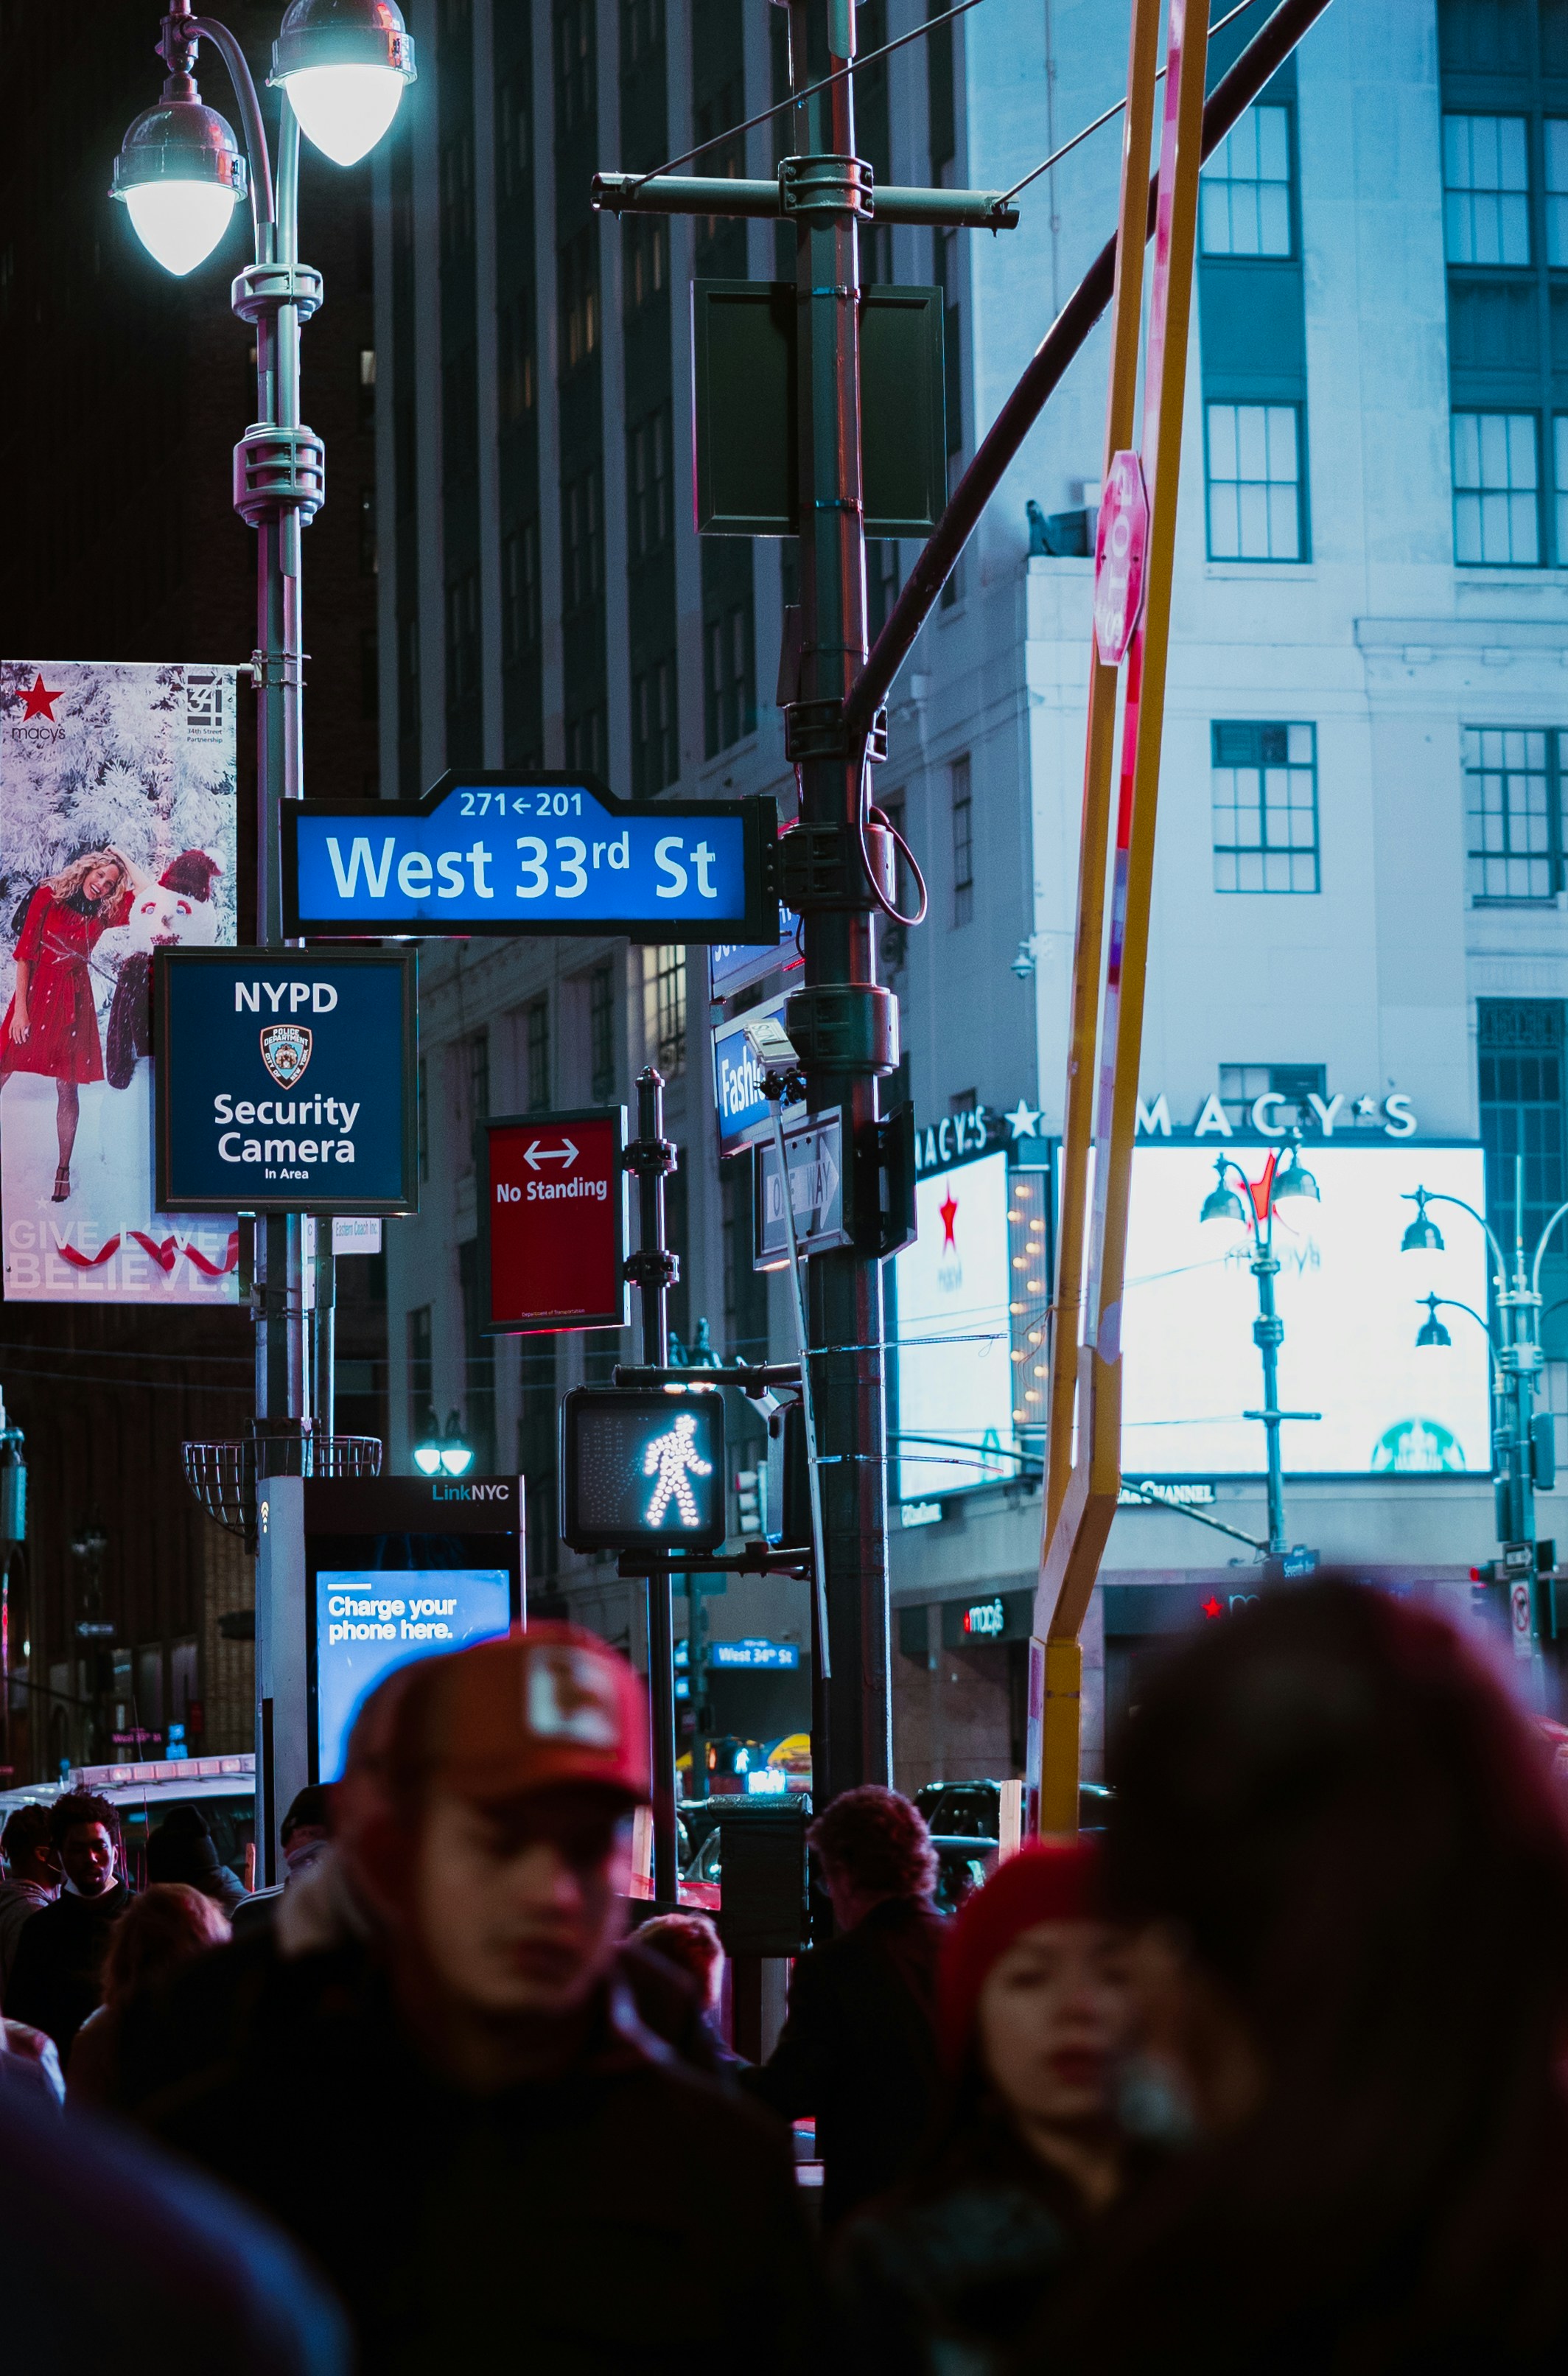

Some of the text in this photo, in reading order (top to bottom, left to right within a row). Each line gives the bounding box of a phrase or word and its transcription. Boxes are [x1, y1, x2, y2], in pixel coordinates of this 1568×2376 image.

[326, 831, 718, 898] West 33rd St
[235, 982, 338, 1013] NYPD
[264, 1034, 309, 1047] DEPARTMENT
[273, 1027, 300, 1036] POLICE
[265, 1052, 275, 1068] CITY
[290, 1049, 309, 1081] NEW YORK
[214, 1093, 360, 1133] Security
[217, 1132, 355, 1163] Camera
[265, 1168, 309, 1179] In Area
[497, 1177, 607, 1203] No Standing
[773, 1161, 831, 1217] OE WAY
[8, 1220, 220, 1251] GIVE LOVE
[9, 1252, 230, 1291] BELIEVE.
[432, 1484, 510, 1500] LinkNYC
[328, 1596, 457, 1621] Charge your
[329, 1618, 453, 1646] phone here.
[718, 1647, 751, 1663] West
[778, 1649, 792, 1664] St
